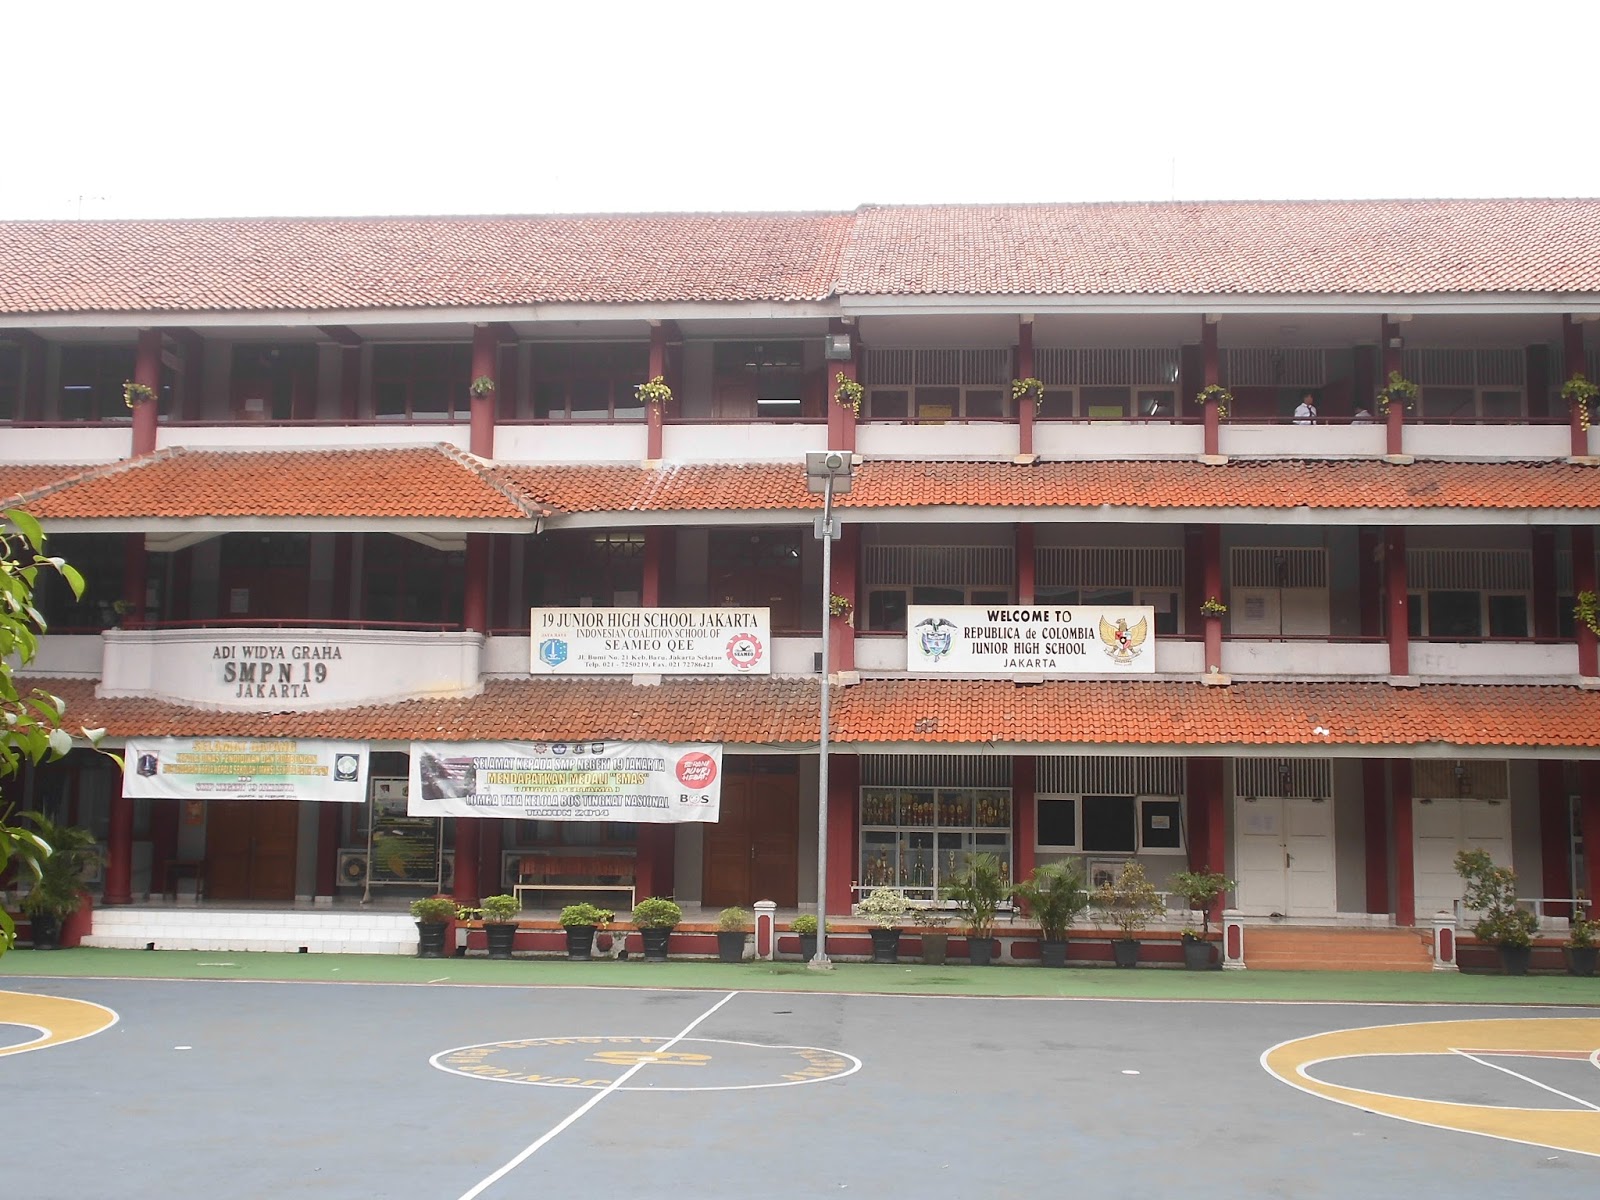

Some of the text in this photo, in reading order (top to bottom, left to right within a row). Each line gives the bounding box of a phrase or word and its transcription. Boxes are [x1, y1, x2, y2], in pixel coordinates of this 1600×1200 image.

[542, 613, 758, 628] 19 JUNIOR HIGH SCHOOL JAKARTA
[987, 610, 1072, 622] WELCOME TO
[576, 629, 720, 638] INDONESIAN COALITION SCHOOL OF
[964, 627, 1095, 639] REPUBLICA de COLOMBIA
[605, 640, 694, 652] SEAMEO QEE
[972, 642, 1086, 654] JUNIOR HIGH SCHOOL
[212, 646, 342, 660] ADI WIDYA GRAHA
[1004, 659, 1056, 668] JAKARTA
[224, 662, 327, 684] SMPN 19
[236, 684, 310, 698] JAKARTA
[474, 757, 665, 772] SELAMAT KEPADA SMP NEGERI 19 JAKARTA
[487, 772, 650, 784] MENDAPATKAN MEDALI "EMAS"
[466, 794, 498, 806] LOMBA
[501, 795, 522, 806] TATA
[524, 795, 558, 806] KELOLA
[560, 795, 580, 807] BOS
[582, 796, 624, 807] TINGKAT
[624, 796, 670, 808] NASIONAL
